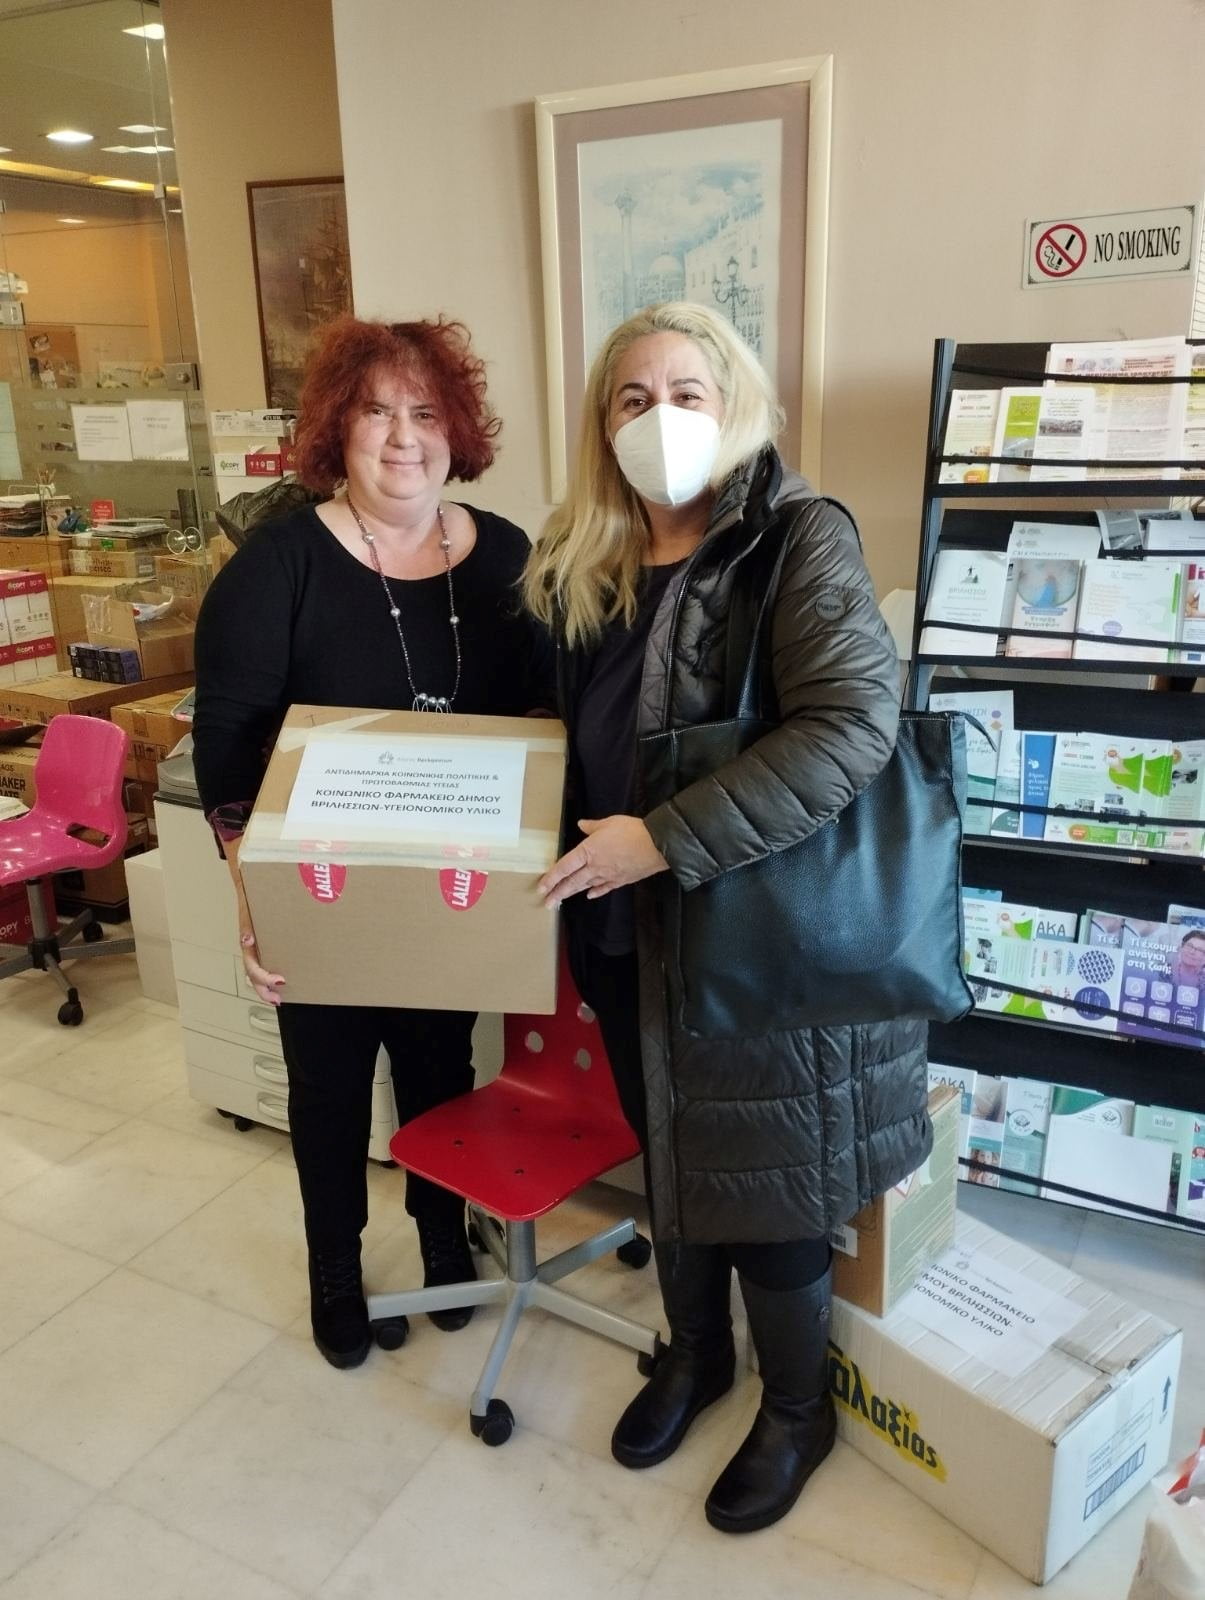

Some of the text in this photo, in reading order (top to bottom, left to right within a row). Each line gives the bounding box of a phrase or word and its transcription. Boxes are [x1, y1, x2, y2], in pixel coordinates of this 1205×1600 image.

[1093, 226, 1181, 264] NO SMOKING
[324, 768, 390, 777] ΑΝΤΙΔΗΜΑΡΧΙΑ
[391, 771, 444, 779] ΚΟΙΝΩΝΙΚΗΣ
[0, 776, 26, 791] AKER
[361, 779, 431, 788] ΠΡΩΤΟΒΑΘΜΙΑΣ
[315, 789, 501, 803] ΚΟΙΝΩΝΙΚΟ ΦΑΡΜΑΚΕΙΟ ΔΗΜΟΥ
[310, 800, 501, 815] ΒΡΙΛΗΣΣΙΩΝ-ΥΓΕΙΟΝΟΜΙΚΟ ΥΛΙΚΟ
[313, 853, 334, 899] LALLE
[451, 860, 472, 908] LALLE
[0, 920, 18, 936] OPY
[1036, 920, 1067, 937] ΑΚΑ
[1142, 937, 1178, 953] έχουμε
[1128, 947, 1166, 963] ανάγκη
[1127, 958, 1172, 975] στη ζωή;
[921, 1271, 1014, 1328] ΜΟΥ ΒΡΙΛΗΣΣΙΩΝ-
[969, 1284, 1036, 1324] ΦΑΡΜΑΚΕΙΟ
[912, 1281, 969, 1318] ΙΟΝΟΜΙΚΟ
[971, 1315, 1004, 1337] ΥΛΙΚΟ
